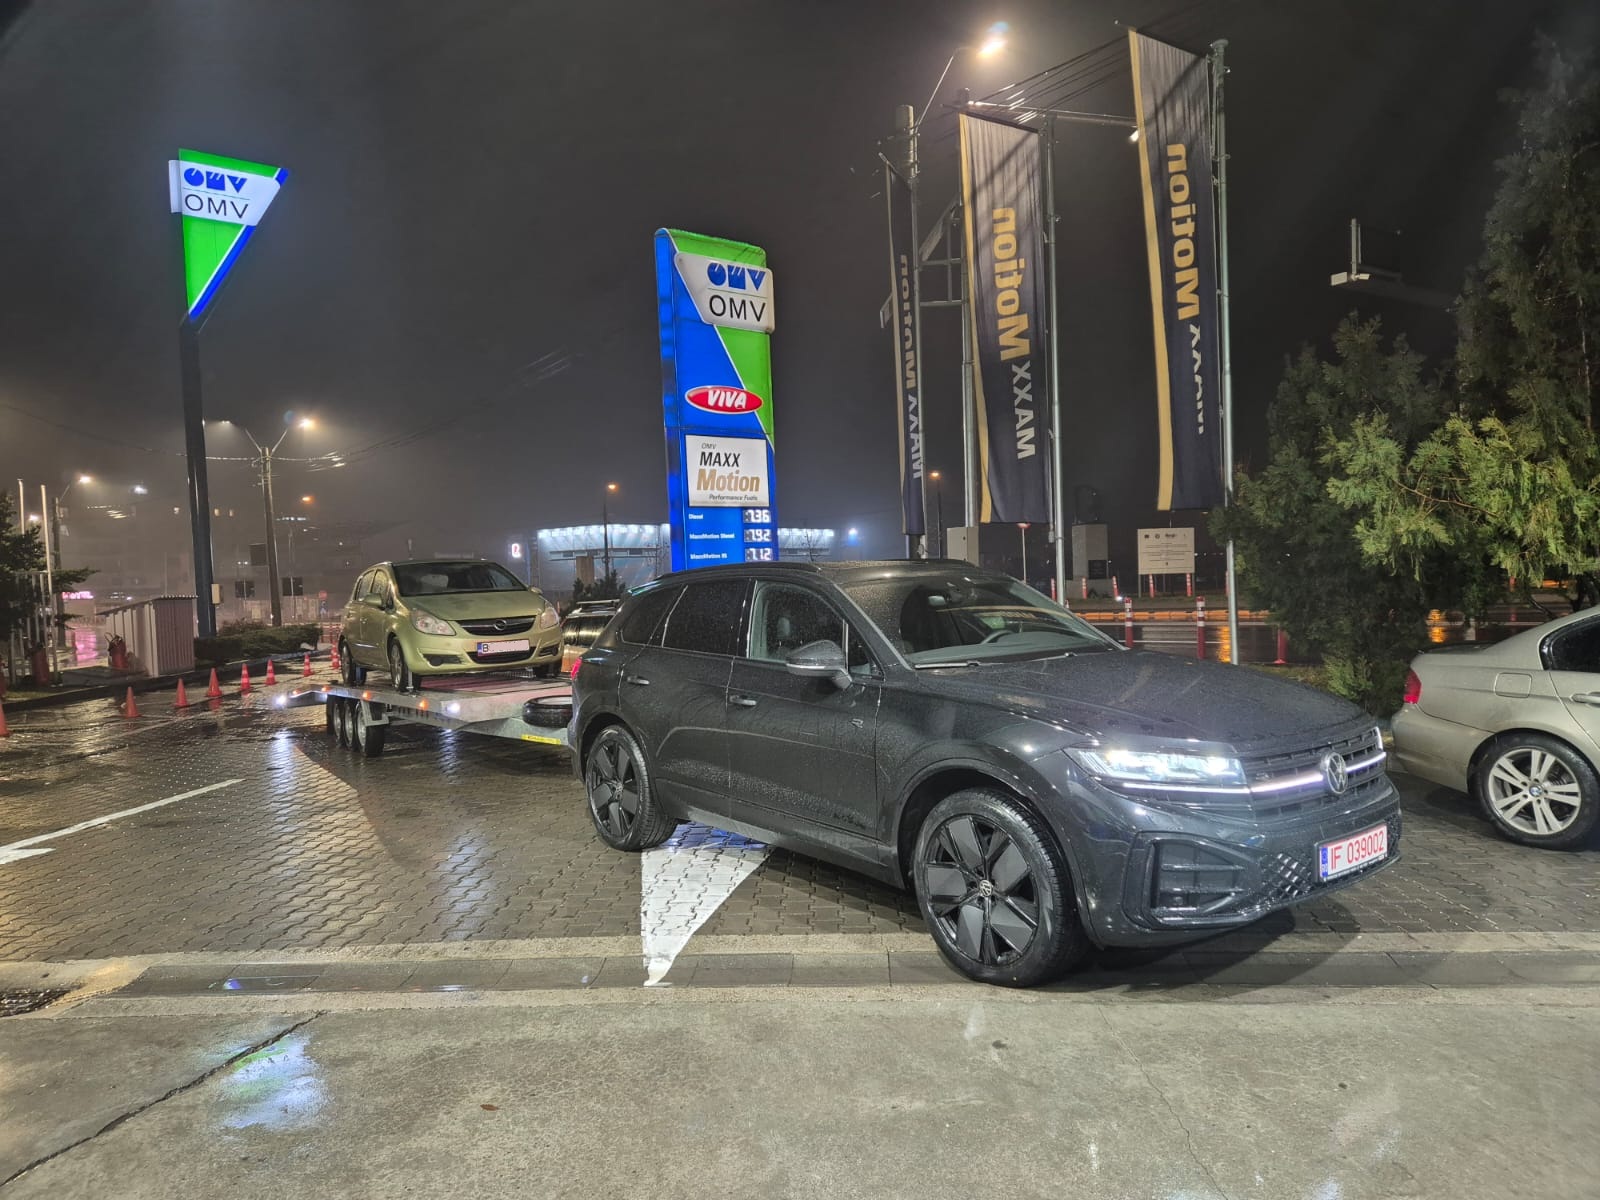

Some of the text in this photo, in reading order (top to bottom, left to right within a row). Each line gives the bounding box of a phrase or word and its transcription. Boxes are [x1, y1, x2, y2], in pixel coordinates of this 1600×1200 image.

[185, 194, 249, 219] OMV
[709, 295, 766, 322] OMV
[707, 390, 747, 409] VIVA
[699, 451, 741, 467] MAXX
[697, 468, 760, 492] Motion
[709, 493, 743, 501] Performance
[1331, 846, 1343, 871] IF
[1347, 831, 1384, 864] 039002
